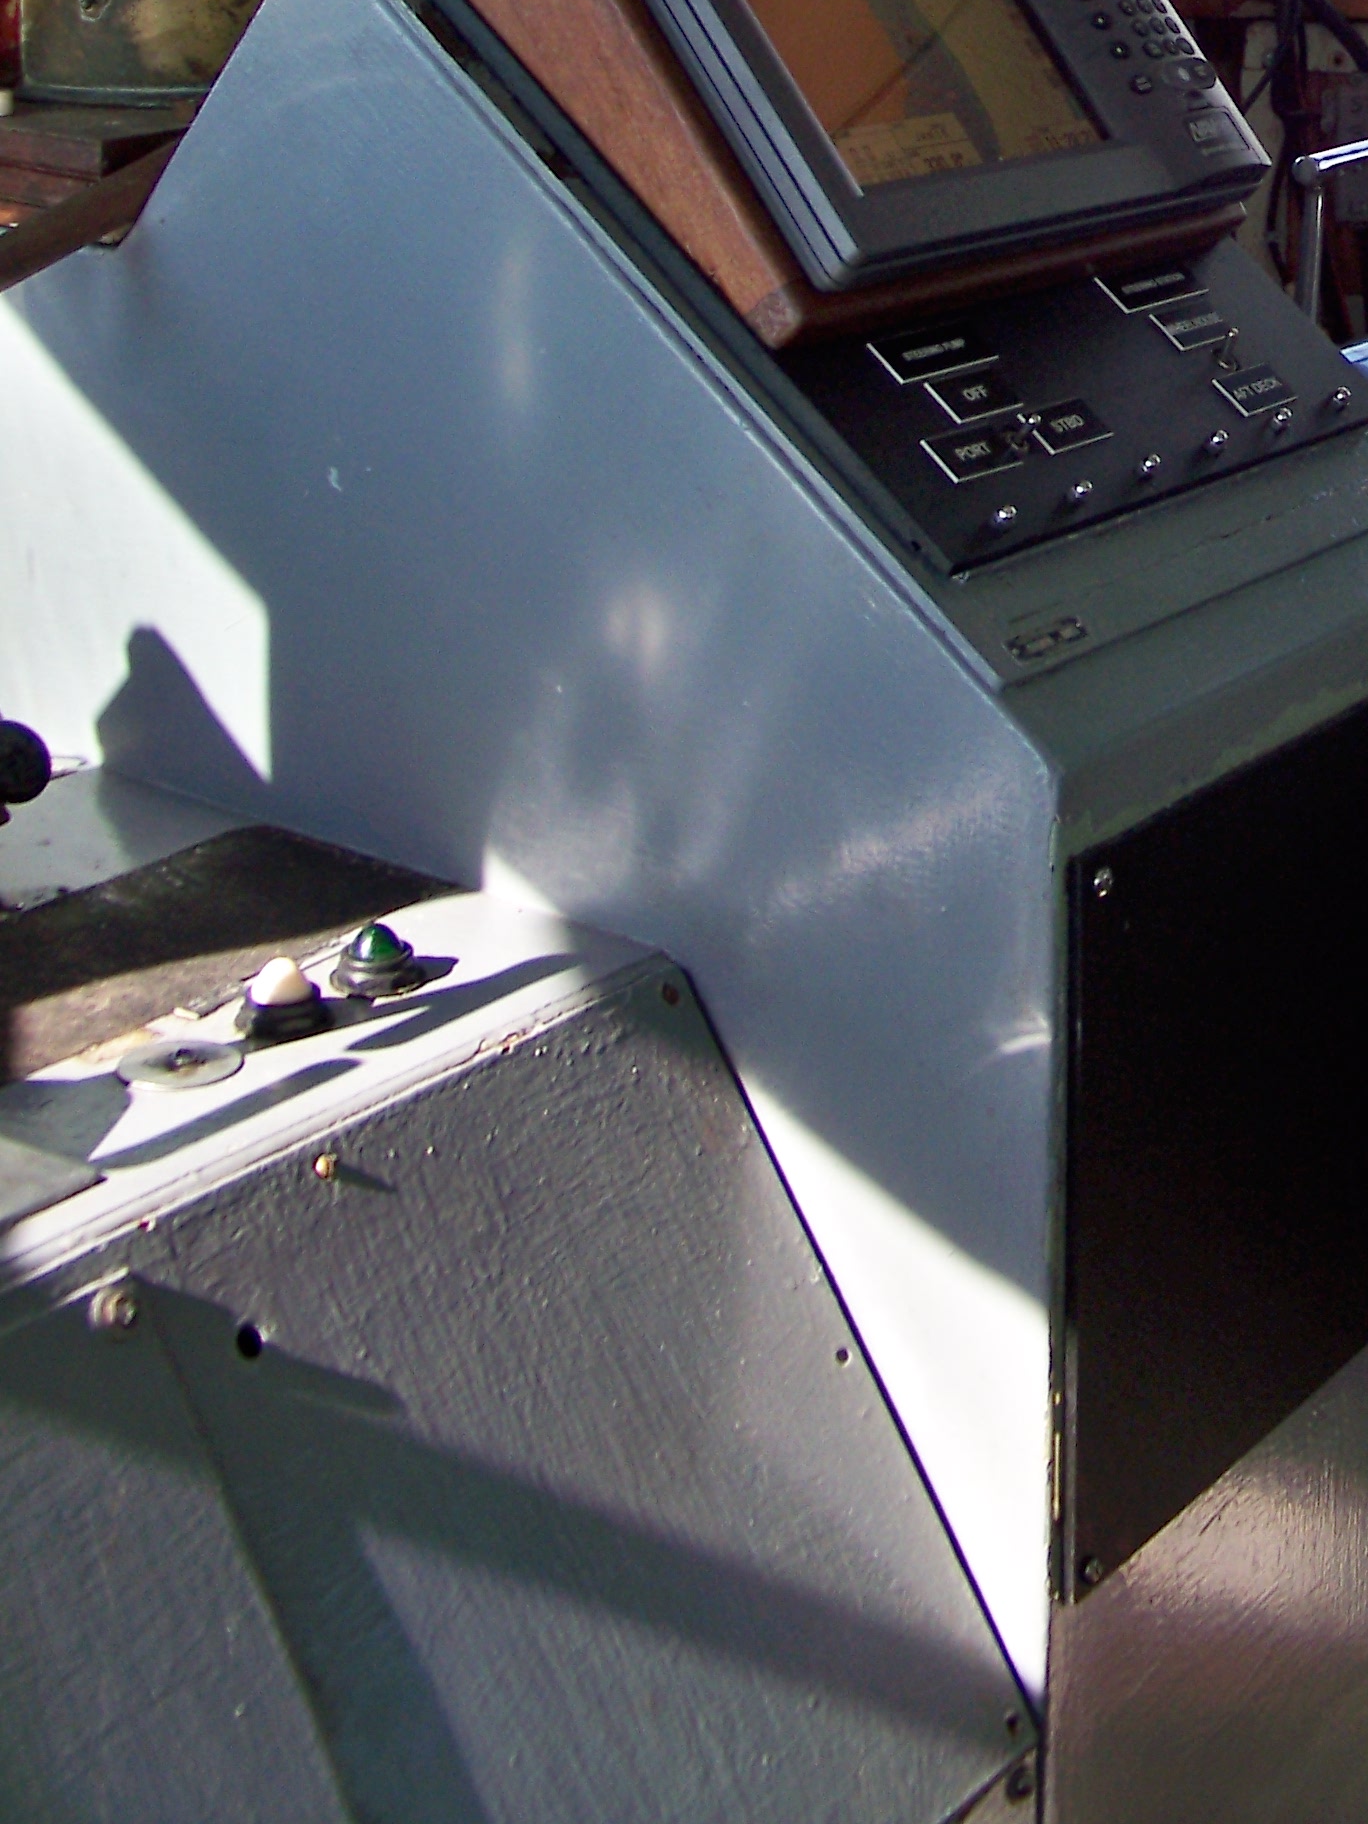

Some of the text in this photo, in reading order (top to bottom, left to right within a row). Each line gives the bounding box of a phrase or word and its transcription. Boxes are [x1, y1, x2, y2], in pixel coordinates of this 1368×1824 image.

[962, 384, 989, 401] OFF
[1233, 376, 1283, 401] AFT DECK
[954, 441, 992, 462] PORT
